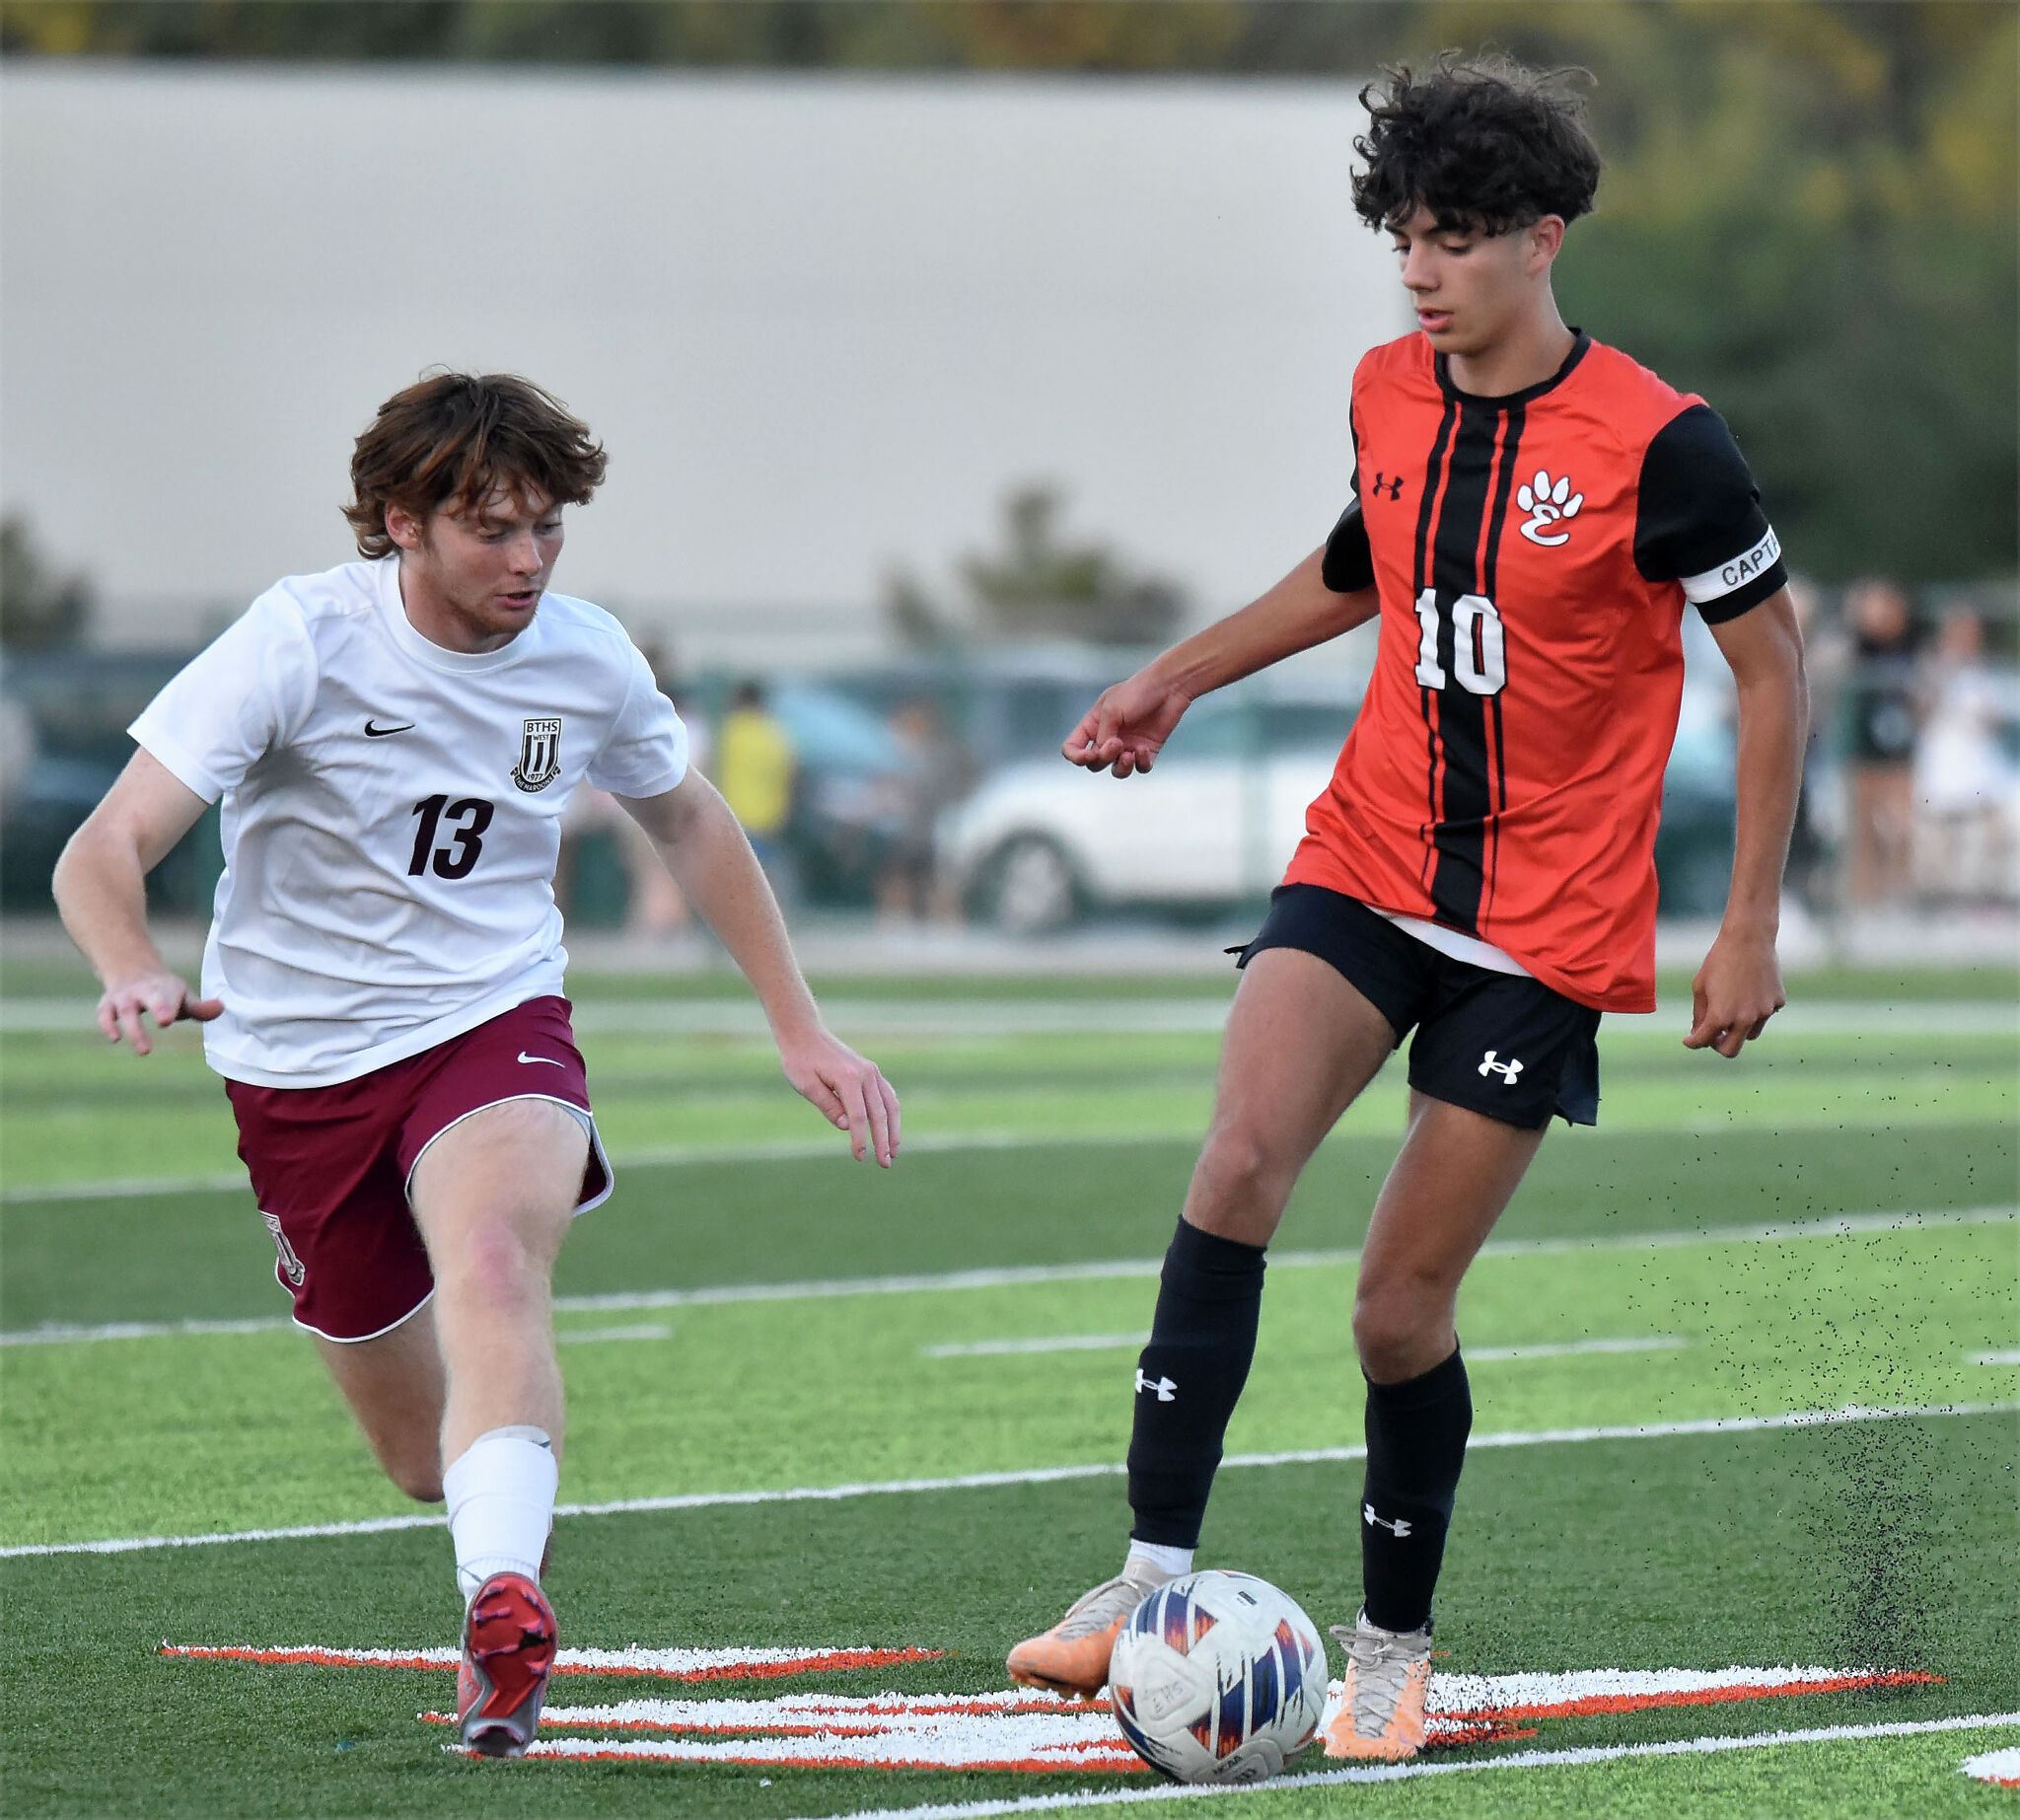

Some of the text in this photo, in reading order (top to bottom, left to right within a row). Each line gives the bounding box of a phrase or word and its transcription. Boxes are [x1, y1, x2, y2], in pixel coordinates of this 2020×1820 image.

[1414, 587, 1508, 696] 10
[526, 721, 558, 733] BTHS
[407, 794, 494, 880] 13
